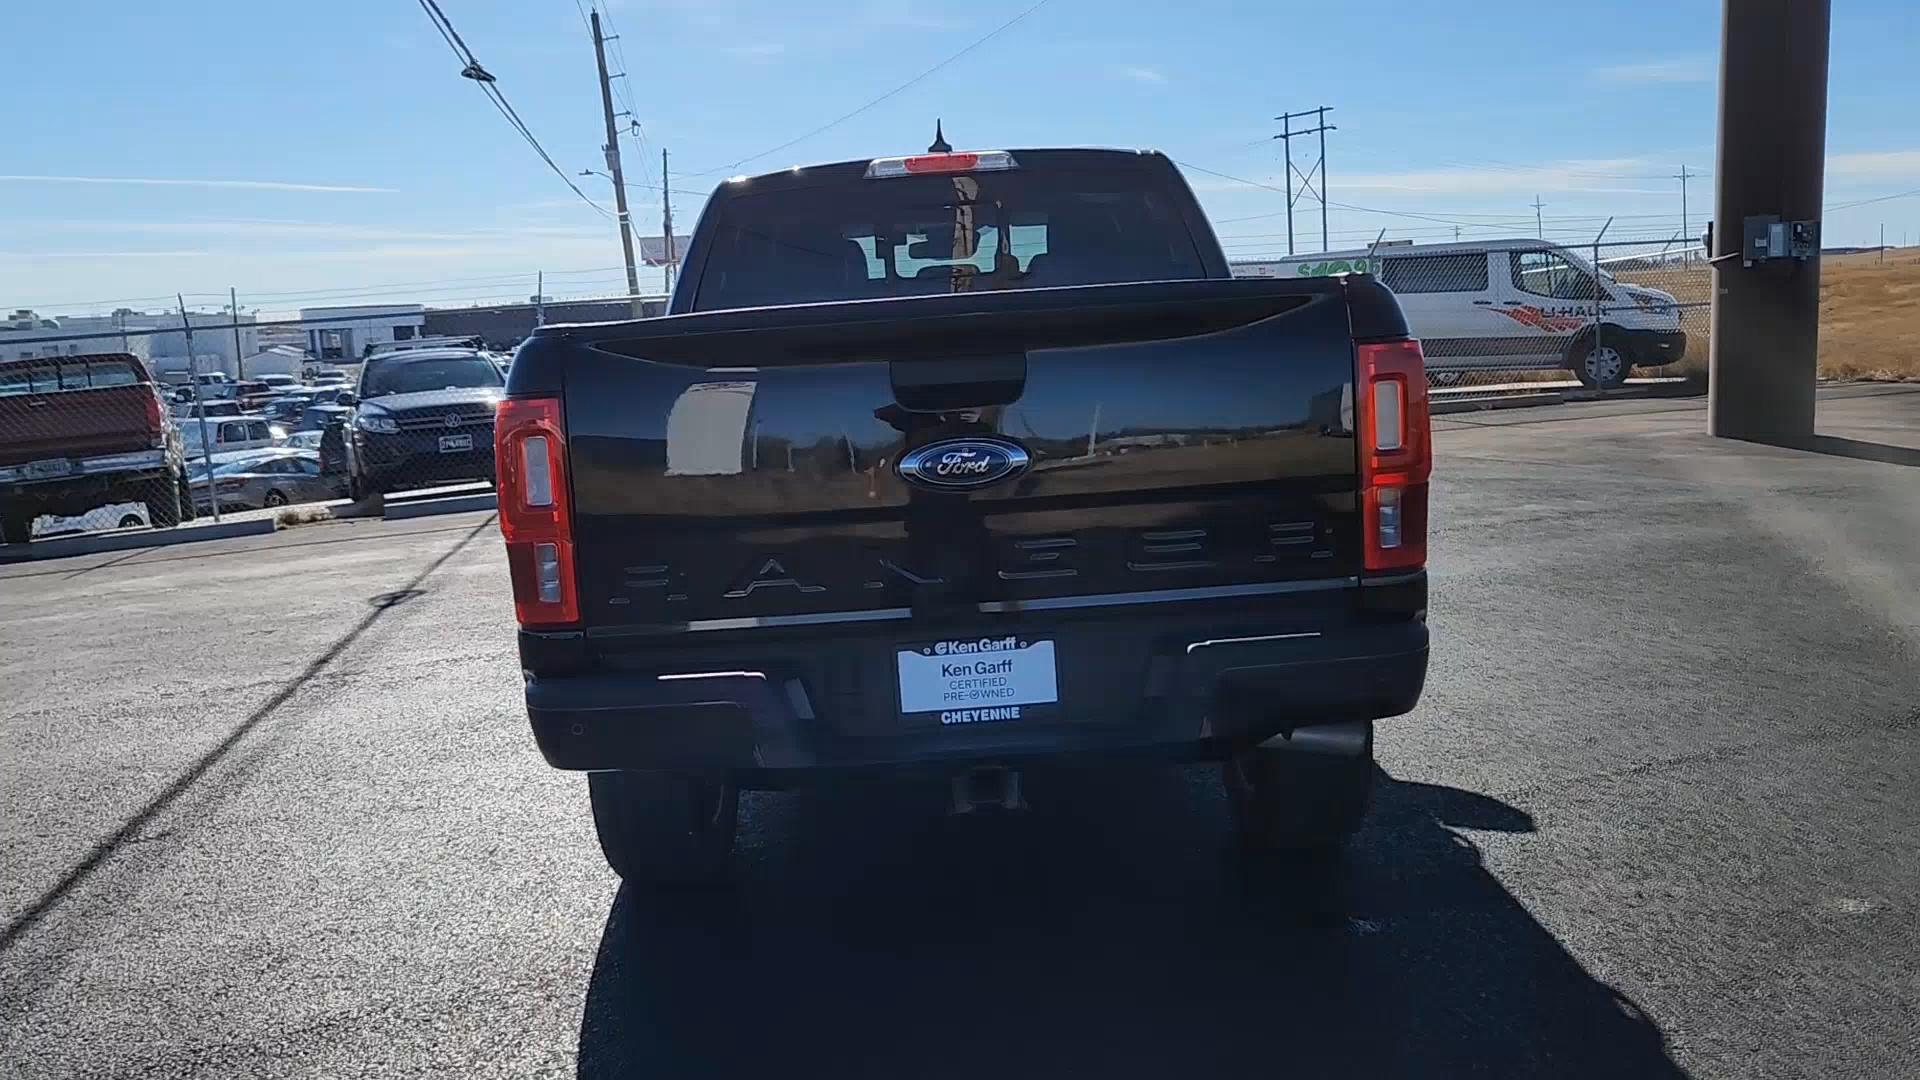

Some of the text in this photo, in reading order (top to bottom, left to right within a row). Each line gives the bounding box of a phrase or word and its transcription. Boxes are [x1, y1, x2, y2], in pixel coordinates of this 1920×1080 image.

[937, 451, 991, 475] Ford
[979, 636, 1017, 651] Garff
[942, 659, 1013, 678] Ken Garff
[949, 676, 1007, 690] CERTIFIED
[941, 707, 1020, 724] CHEYENNE
